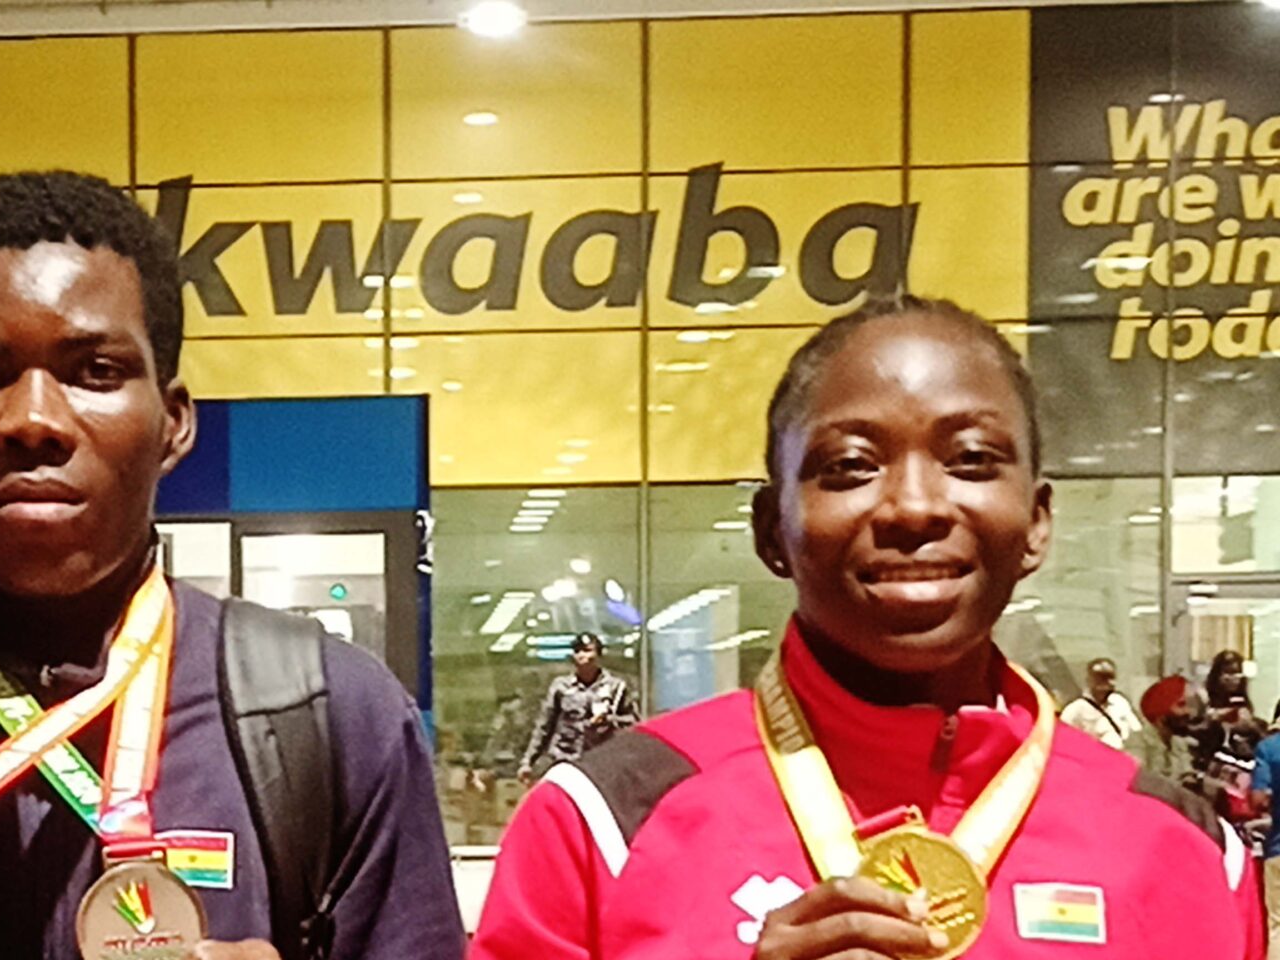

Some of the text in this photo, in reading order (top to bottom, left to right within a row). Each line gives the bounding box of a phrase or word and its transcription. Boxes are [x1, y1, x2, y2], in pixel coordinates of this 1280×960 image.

[1062, 174, 1218, 225] are
[153, 161, 920, 316] kwaaba
[1110, 289, 1280, 360] tod
